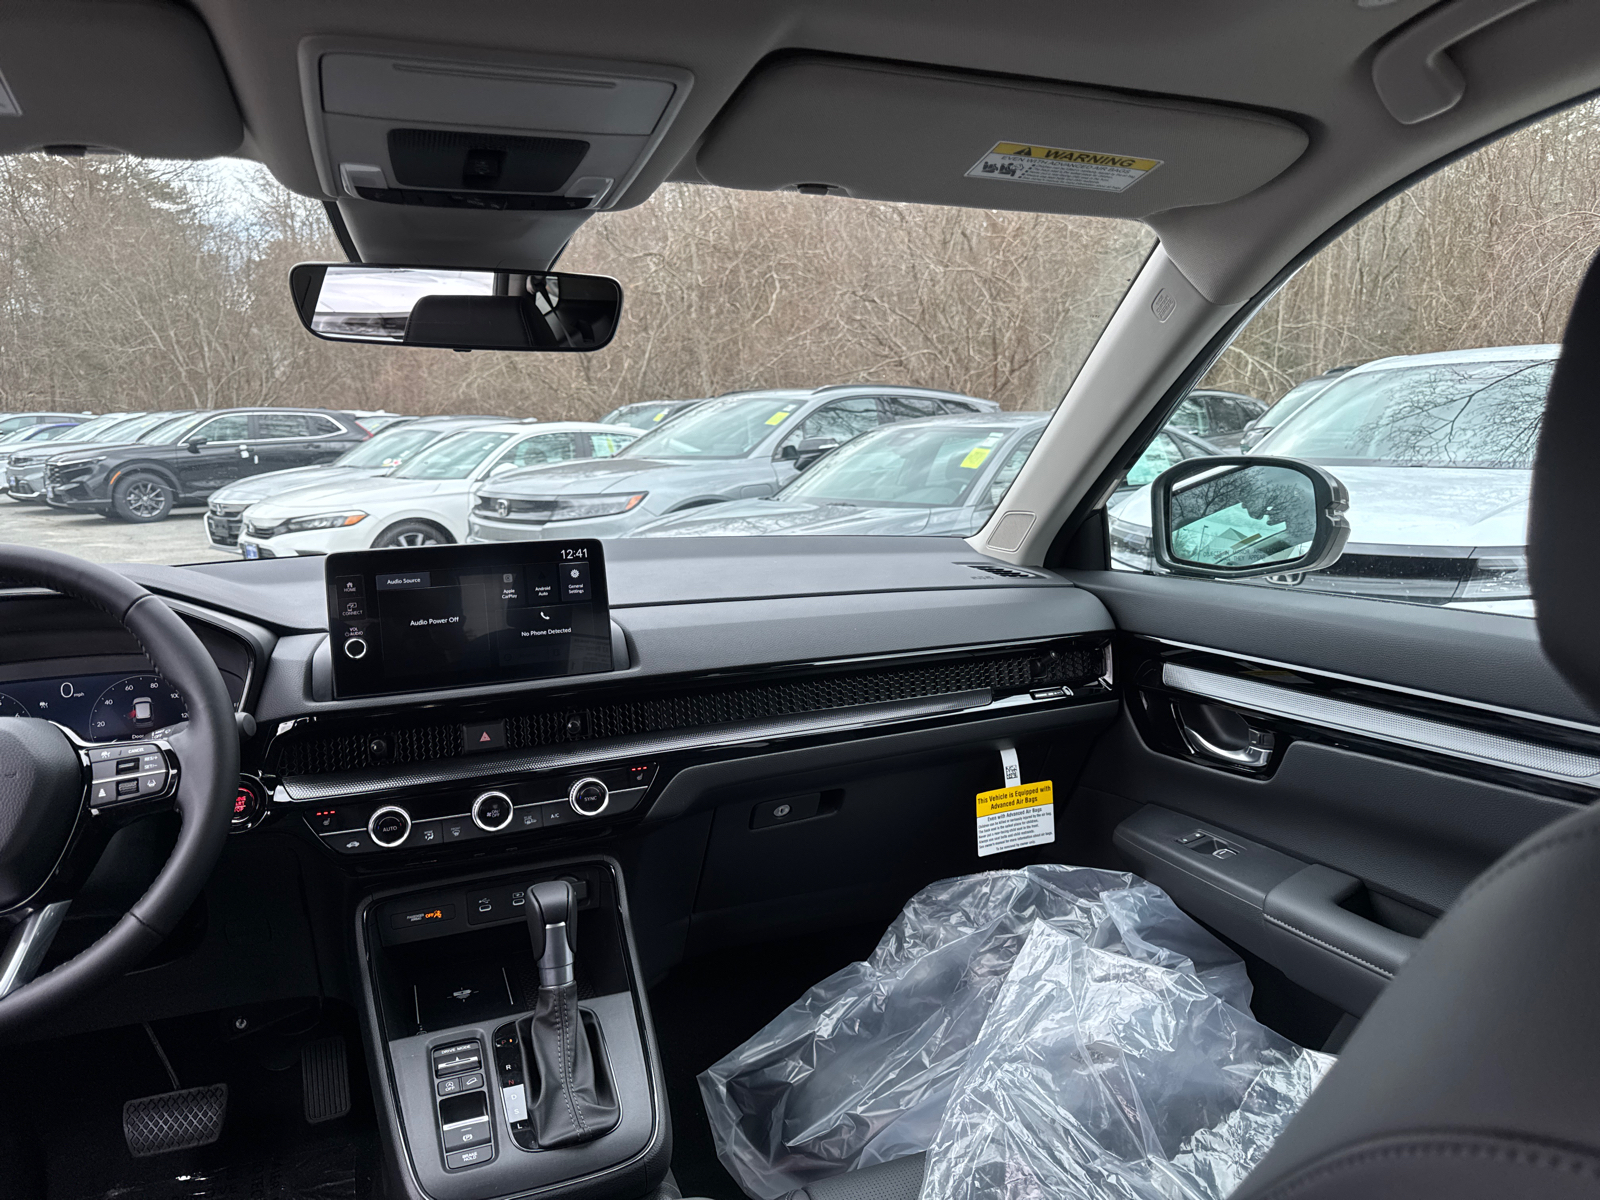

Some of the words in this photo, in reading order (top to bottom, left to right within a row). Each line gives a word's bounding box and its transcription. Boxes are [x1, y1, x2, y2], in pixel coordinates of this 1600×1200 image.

[1044, 150, 1136, 167] WARNING
[561, 548, 587, 559] 12:41
[61, 682, 73, 698] 0
[1015, 788, 1038, 797] Equipped
[991, 801, 1015, 810] Advanced
